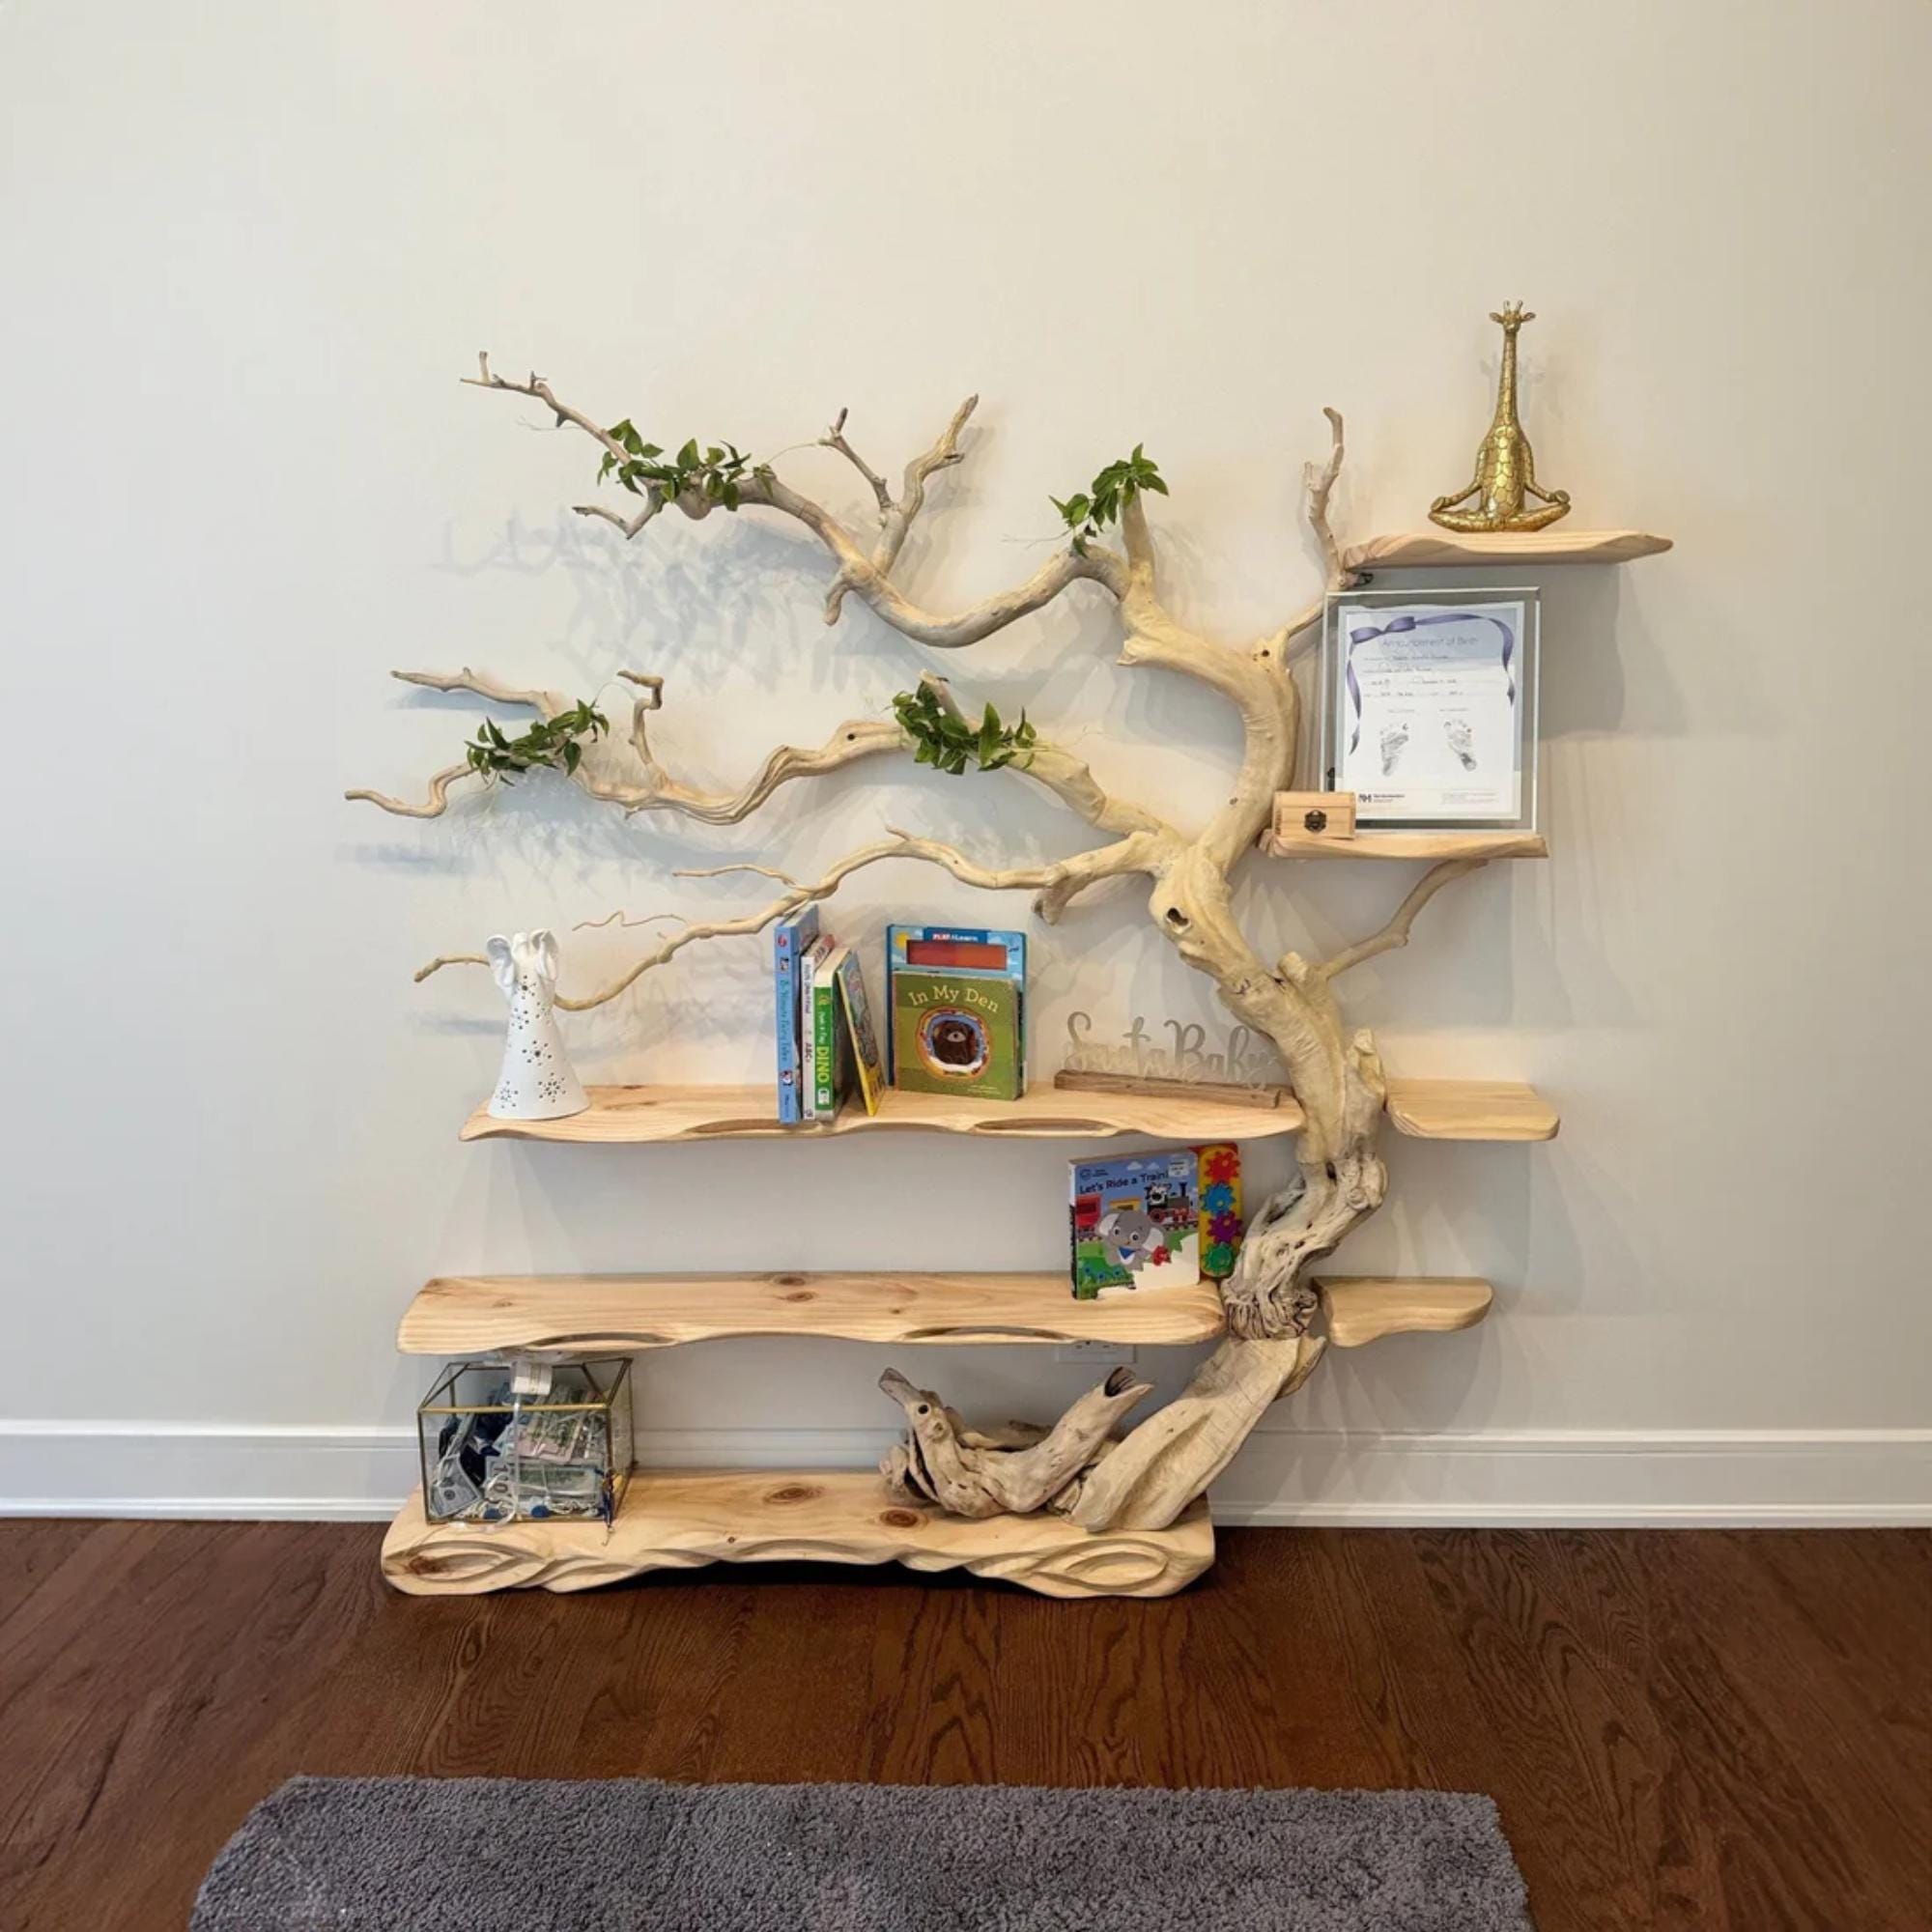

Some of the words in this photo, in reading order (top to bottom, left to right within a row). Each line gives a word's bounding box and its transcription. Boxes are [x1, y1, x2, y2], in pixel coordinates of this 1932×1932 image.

[908, 991, 928, 1006] In
[932, 985, 959, 1003] My
[965, 987, 999, 1012] Den
[816, 1046, 831, 1082] DINO
[1080, 1182, 1103, 1194] Let's
[1106, 1178, 1129, 1189] Ride
[1140, 1169, 1169, 1182] Train!
